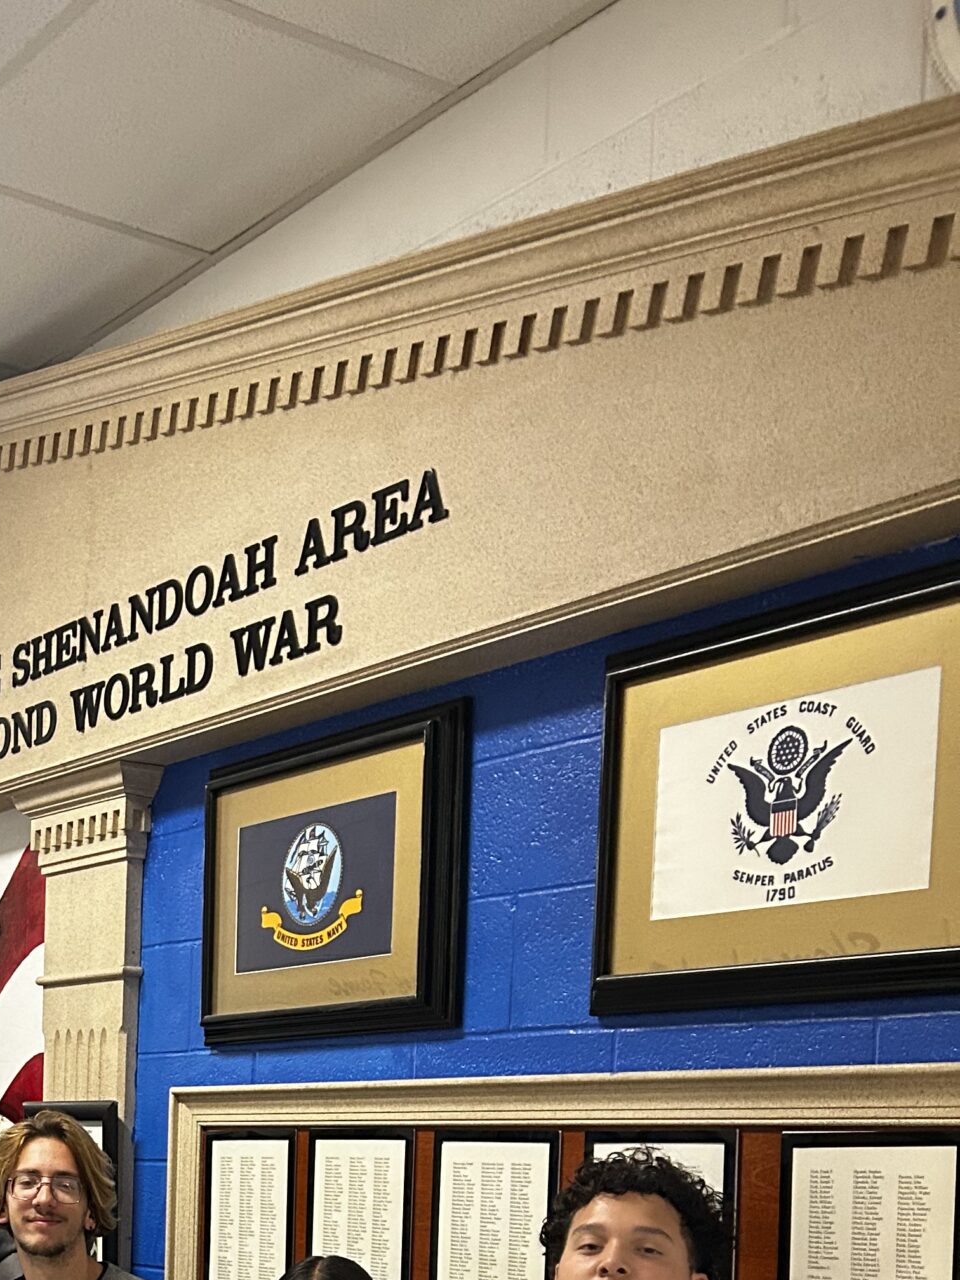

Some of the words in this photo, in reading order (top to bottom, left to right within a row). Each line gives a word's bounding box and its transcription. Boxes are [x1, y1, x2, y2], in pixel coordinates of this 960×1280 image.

[11, 535, 279, 688] SHENANDOAH
[294, 468, 450, 576] AREA
[70, 642, 214, 734] WORLD
[230, 594, 343, 677] WAR
[706, 740, 738, 784] UNITED
[746, 705, 788, 734] STATES
[798, 701, 838, 717] COAST
[845, 716, 876, 755] GUARD
[732, 869, 774, 886] SEMPER
[783, 856, 834, 884] PARATUS
[766, 886, 795, 902] 1790
[276, 931, 299, 947] UNITED
[301, 935, 324, 948] STATES
[327, 923, 344, 939] NAVY
